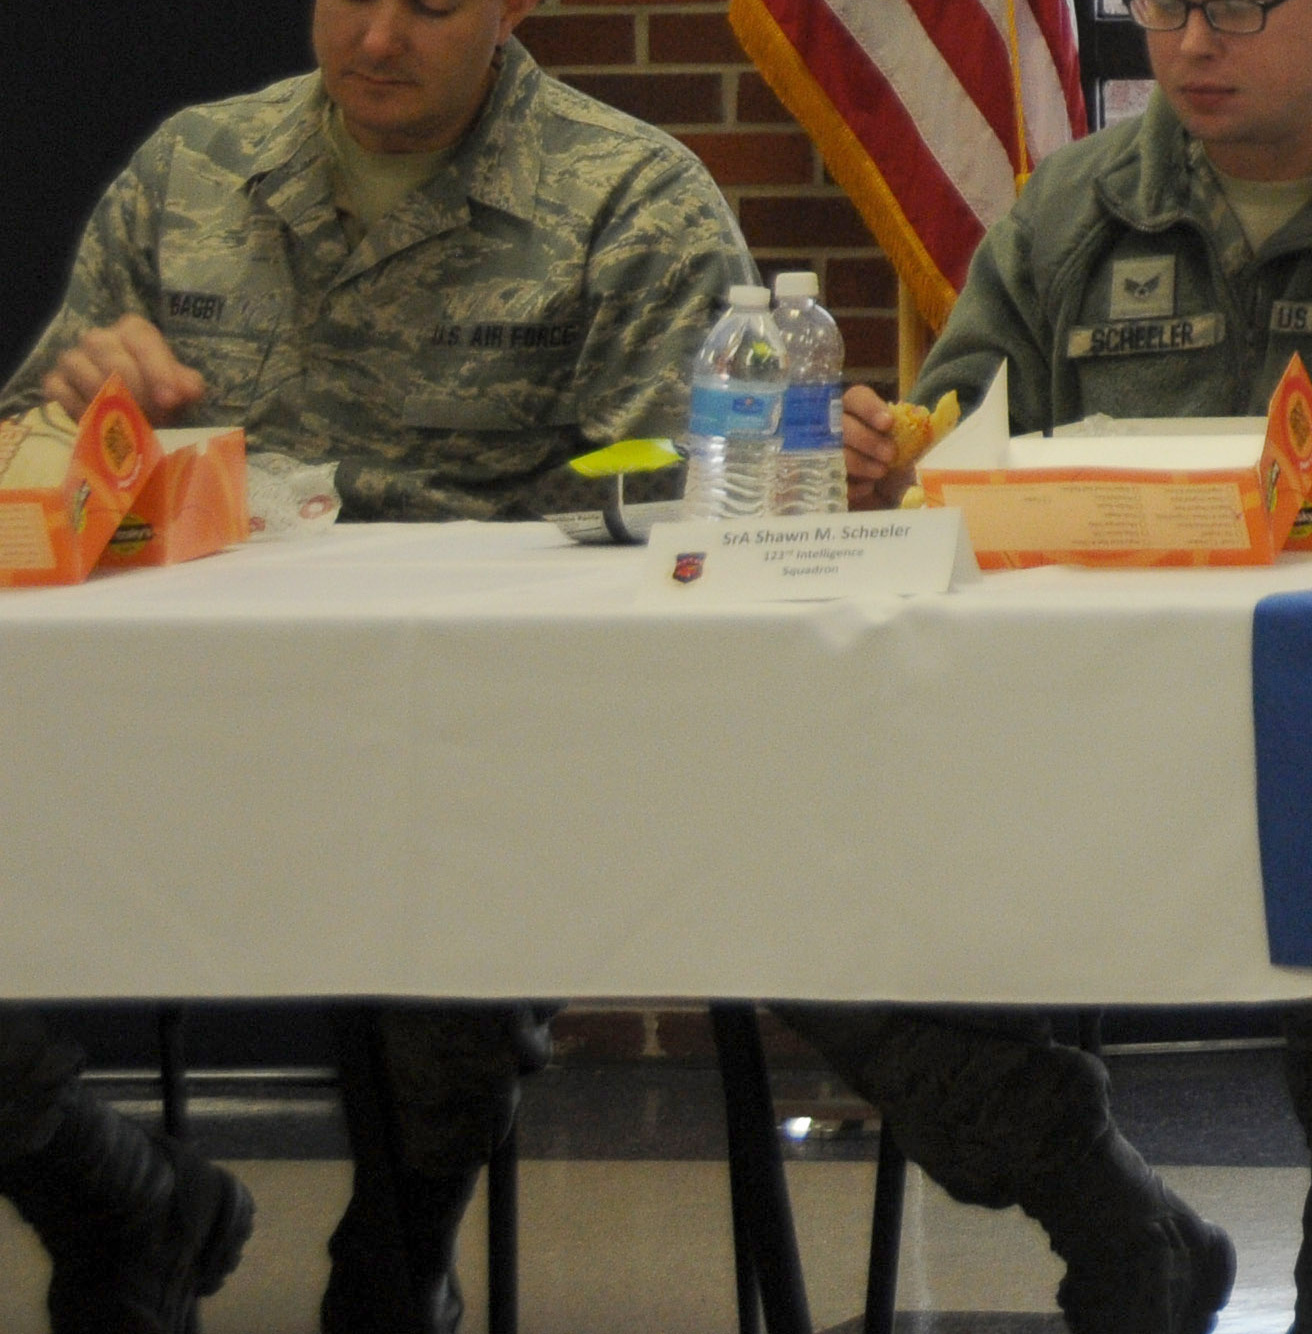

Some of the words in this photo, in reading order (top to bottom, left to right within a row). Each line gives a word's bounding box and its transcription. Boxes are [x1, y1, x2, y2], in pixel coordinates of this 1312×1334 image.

[170, 294, 226, 321] BAGBY
[471, 323, 503, 347] AIR
[511, 322, 575, 348] FORCE
[1091, 320, 1194, 352] SCHEELER
[722, 531, 750, 546] SrA
[755, 528, 809, 545] Shawn
[815, 526, 835, 542] M.
[842, 523, 911, 541] Scheeler
[796, 547, 864, 562] Intelligence
[782, 564, 839, 578] Squadron
